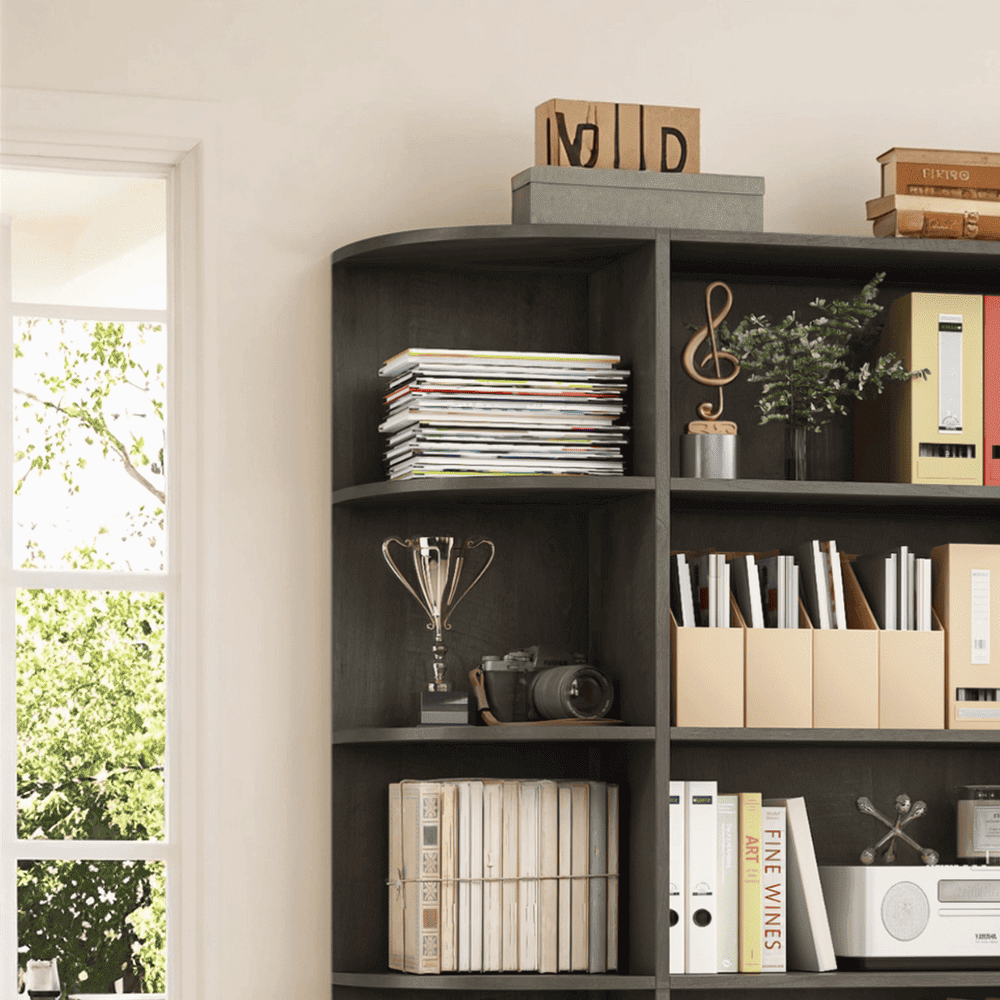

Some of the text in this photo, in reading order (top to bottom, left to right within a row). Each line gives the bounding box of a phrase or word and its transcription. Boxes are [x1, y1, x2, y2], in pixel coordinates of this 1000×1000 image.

[745, 835, 759, 863] ART
[764, 830, 781, 874] FINE
[764, 883, 781, 950] WINES
